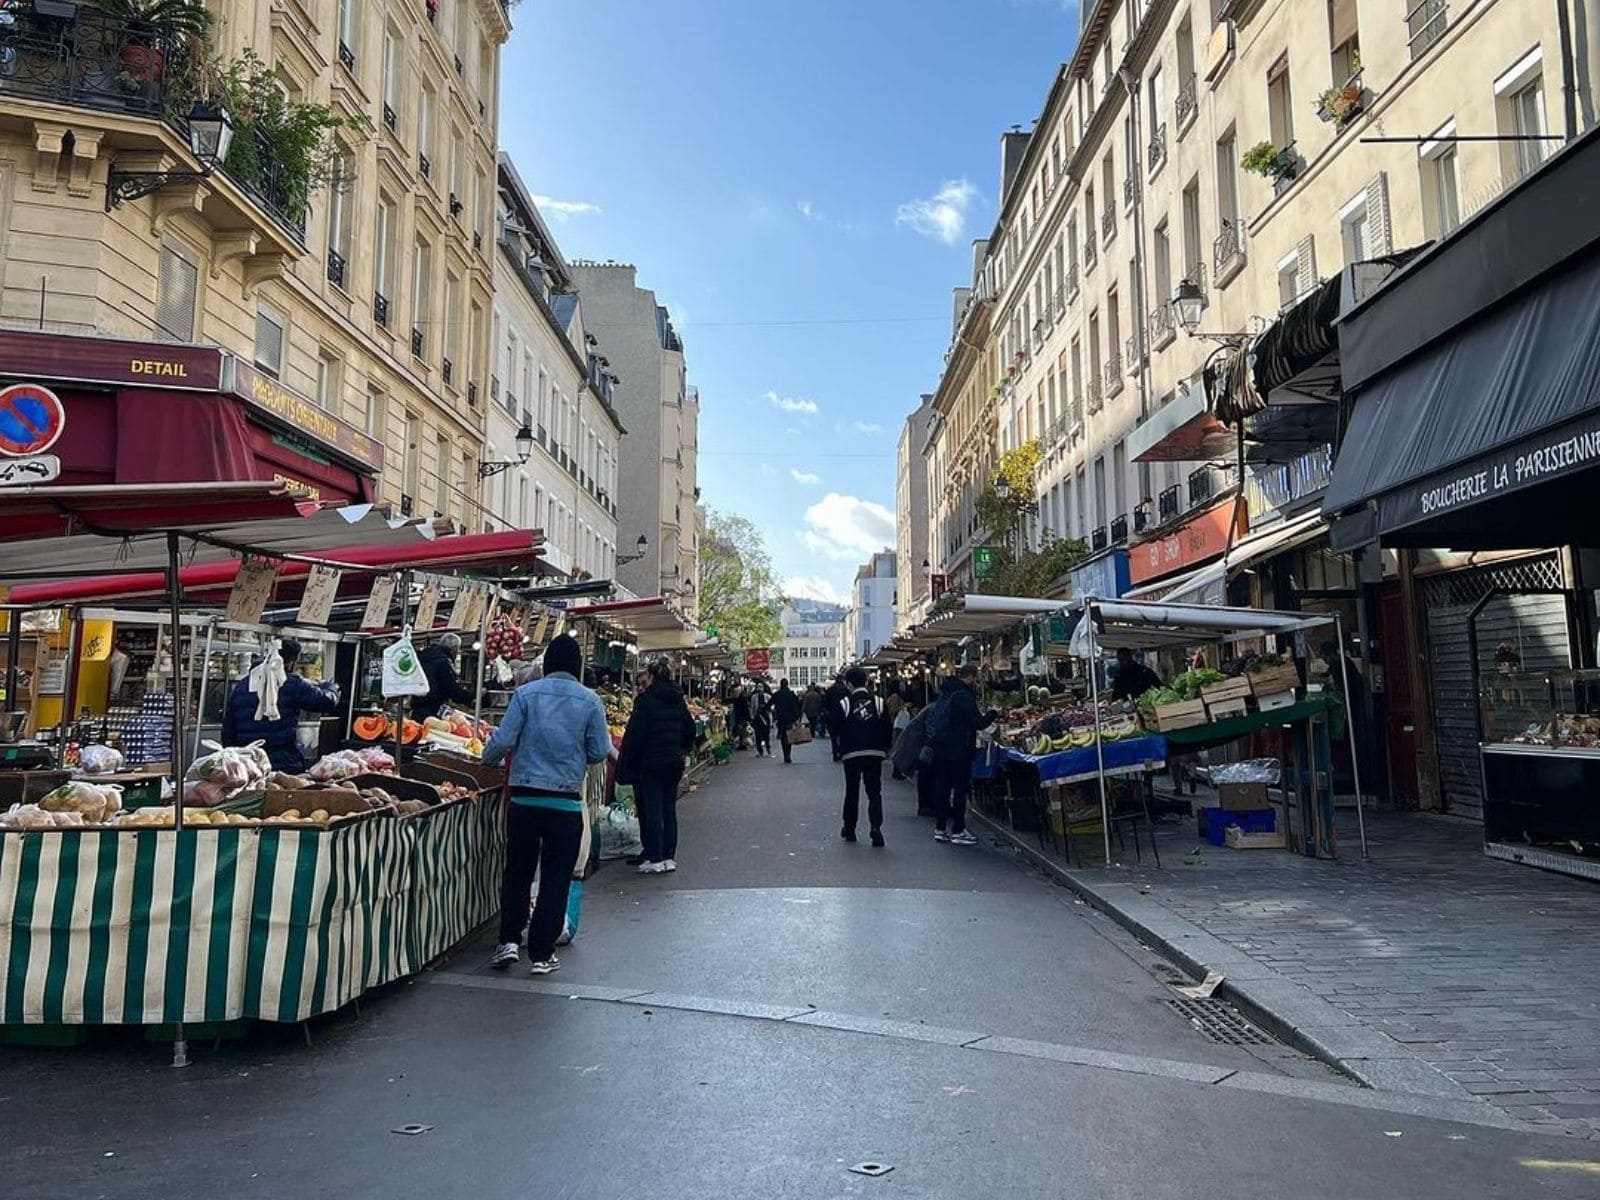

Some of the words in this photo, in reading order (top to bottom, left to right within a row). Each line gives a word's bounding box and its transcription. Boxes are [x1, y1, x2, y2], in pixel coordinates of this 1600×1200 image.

[131, 360, 187, 377] DETAIL
[1420, 471, 1488, 513] BOUCHERIE
[1494, 463, 1509, 489] LA
